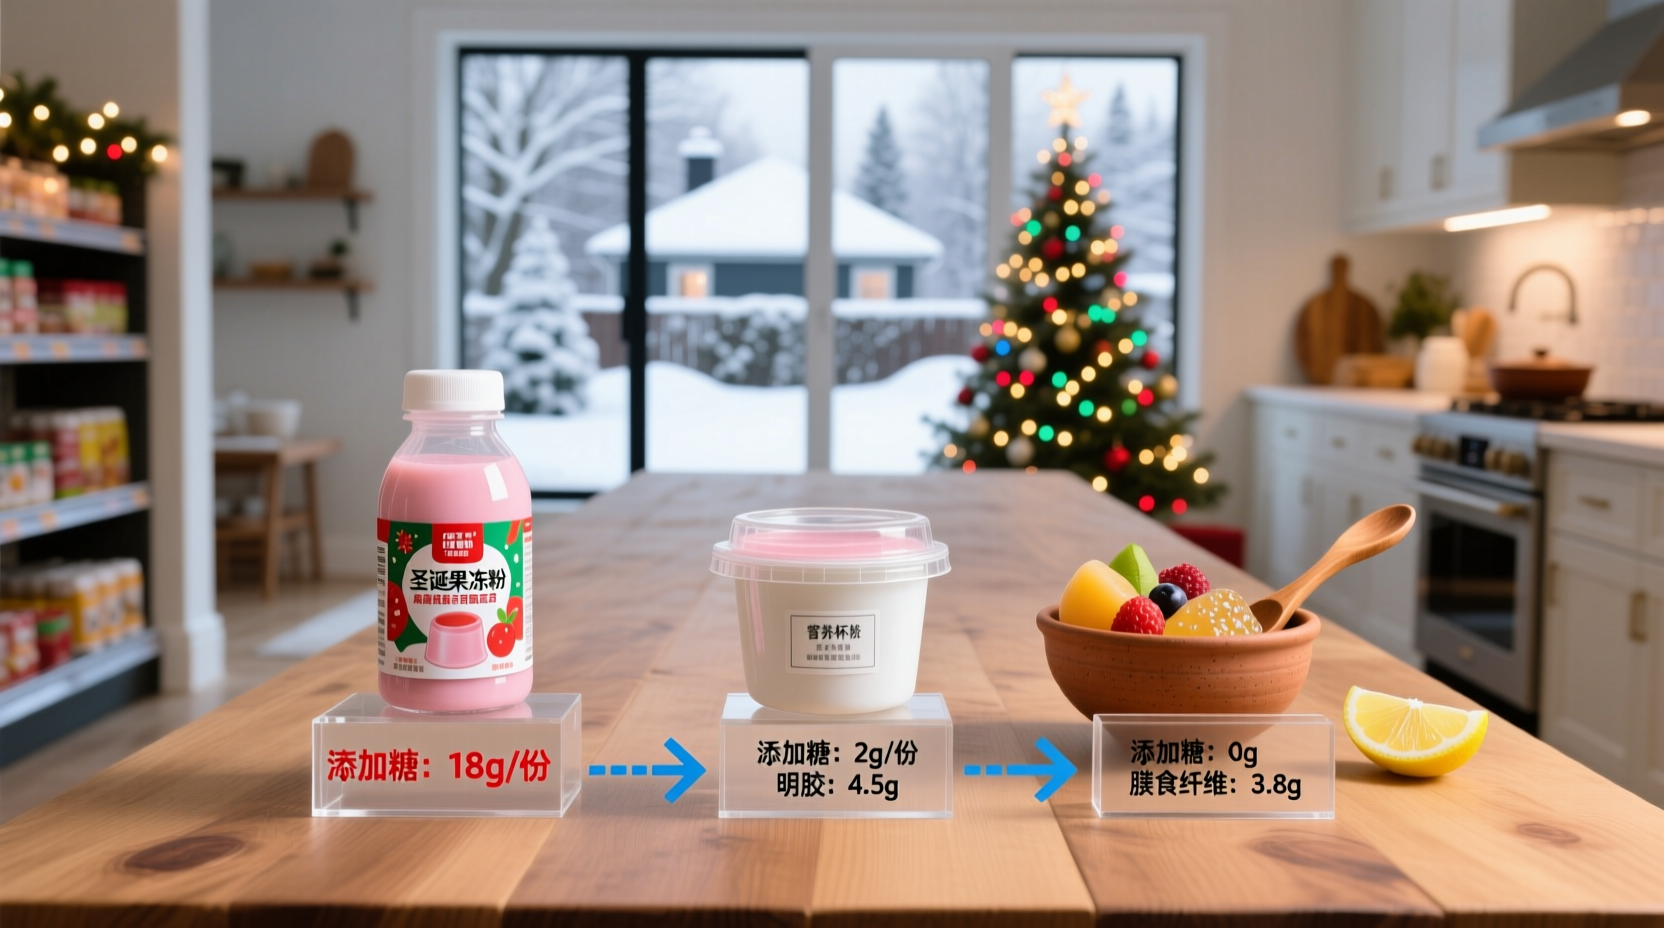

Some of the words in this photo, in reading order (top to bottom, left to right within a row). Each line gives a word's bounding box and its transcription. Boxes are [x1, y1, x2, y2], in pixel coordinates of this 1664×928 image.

[410, 568, 506, 593] 圣诞果冻粉
